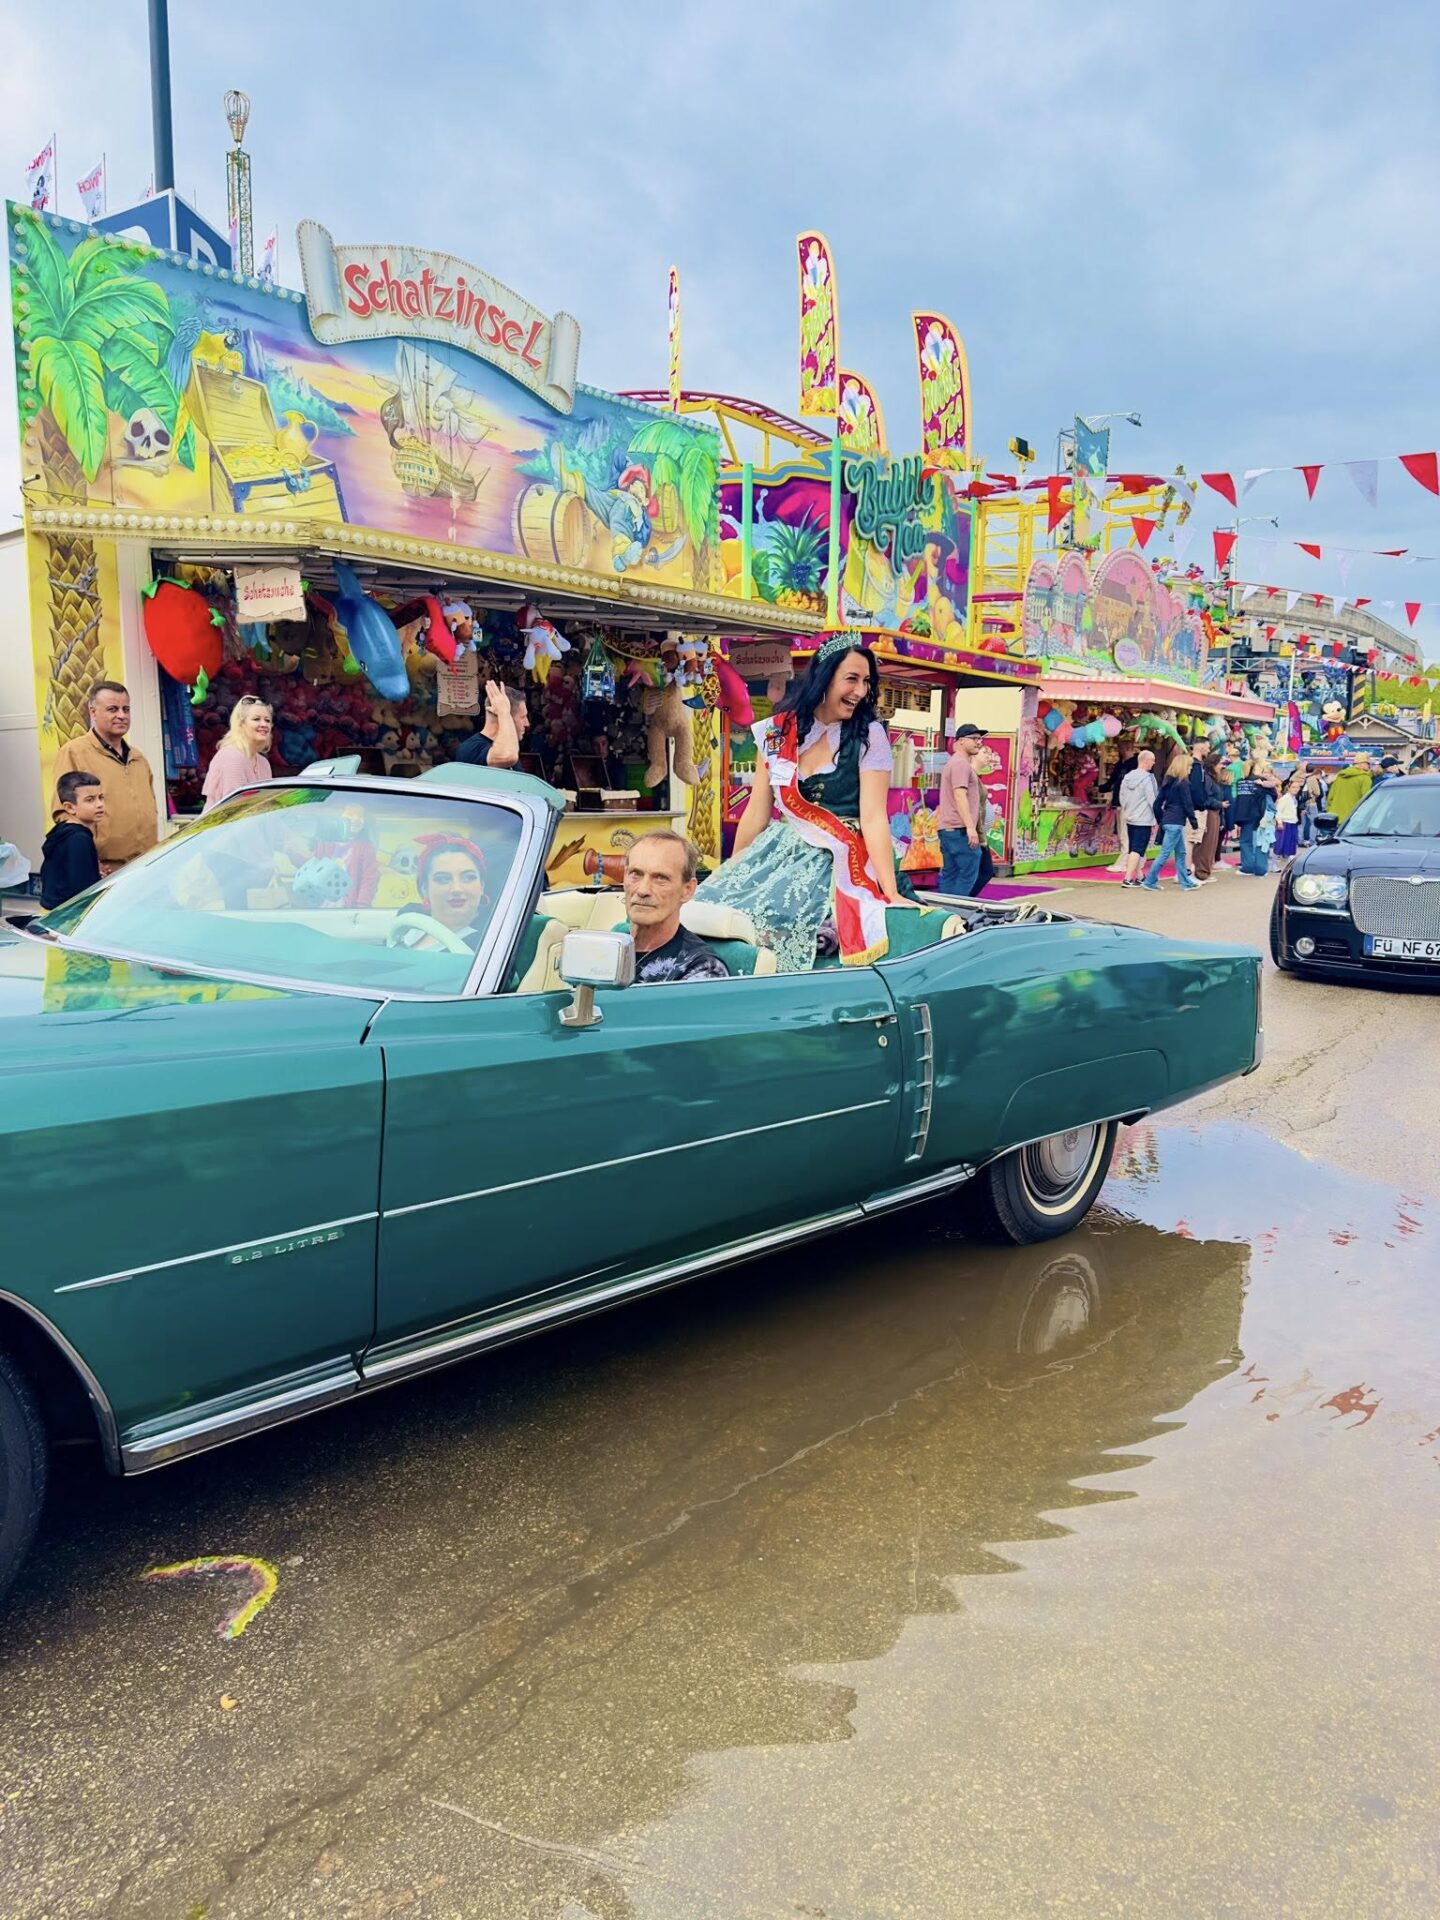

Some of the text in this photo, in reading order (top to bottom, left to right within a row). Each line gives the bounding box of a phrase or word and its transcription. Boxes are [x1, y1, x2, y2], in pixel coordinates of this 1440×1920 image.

[343, 259, 545, 369] Schatzinsel
[845, 455, 936, 536] Bubble
[874, 506, 926, 577] Tea
[1373, 938, 1393, 953] FÜ
[1402, 941, 1422, 954] NF
[231, 1231, 339, 1264] 8.2 LITRE
